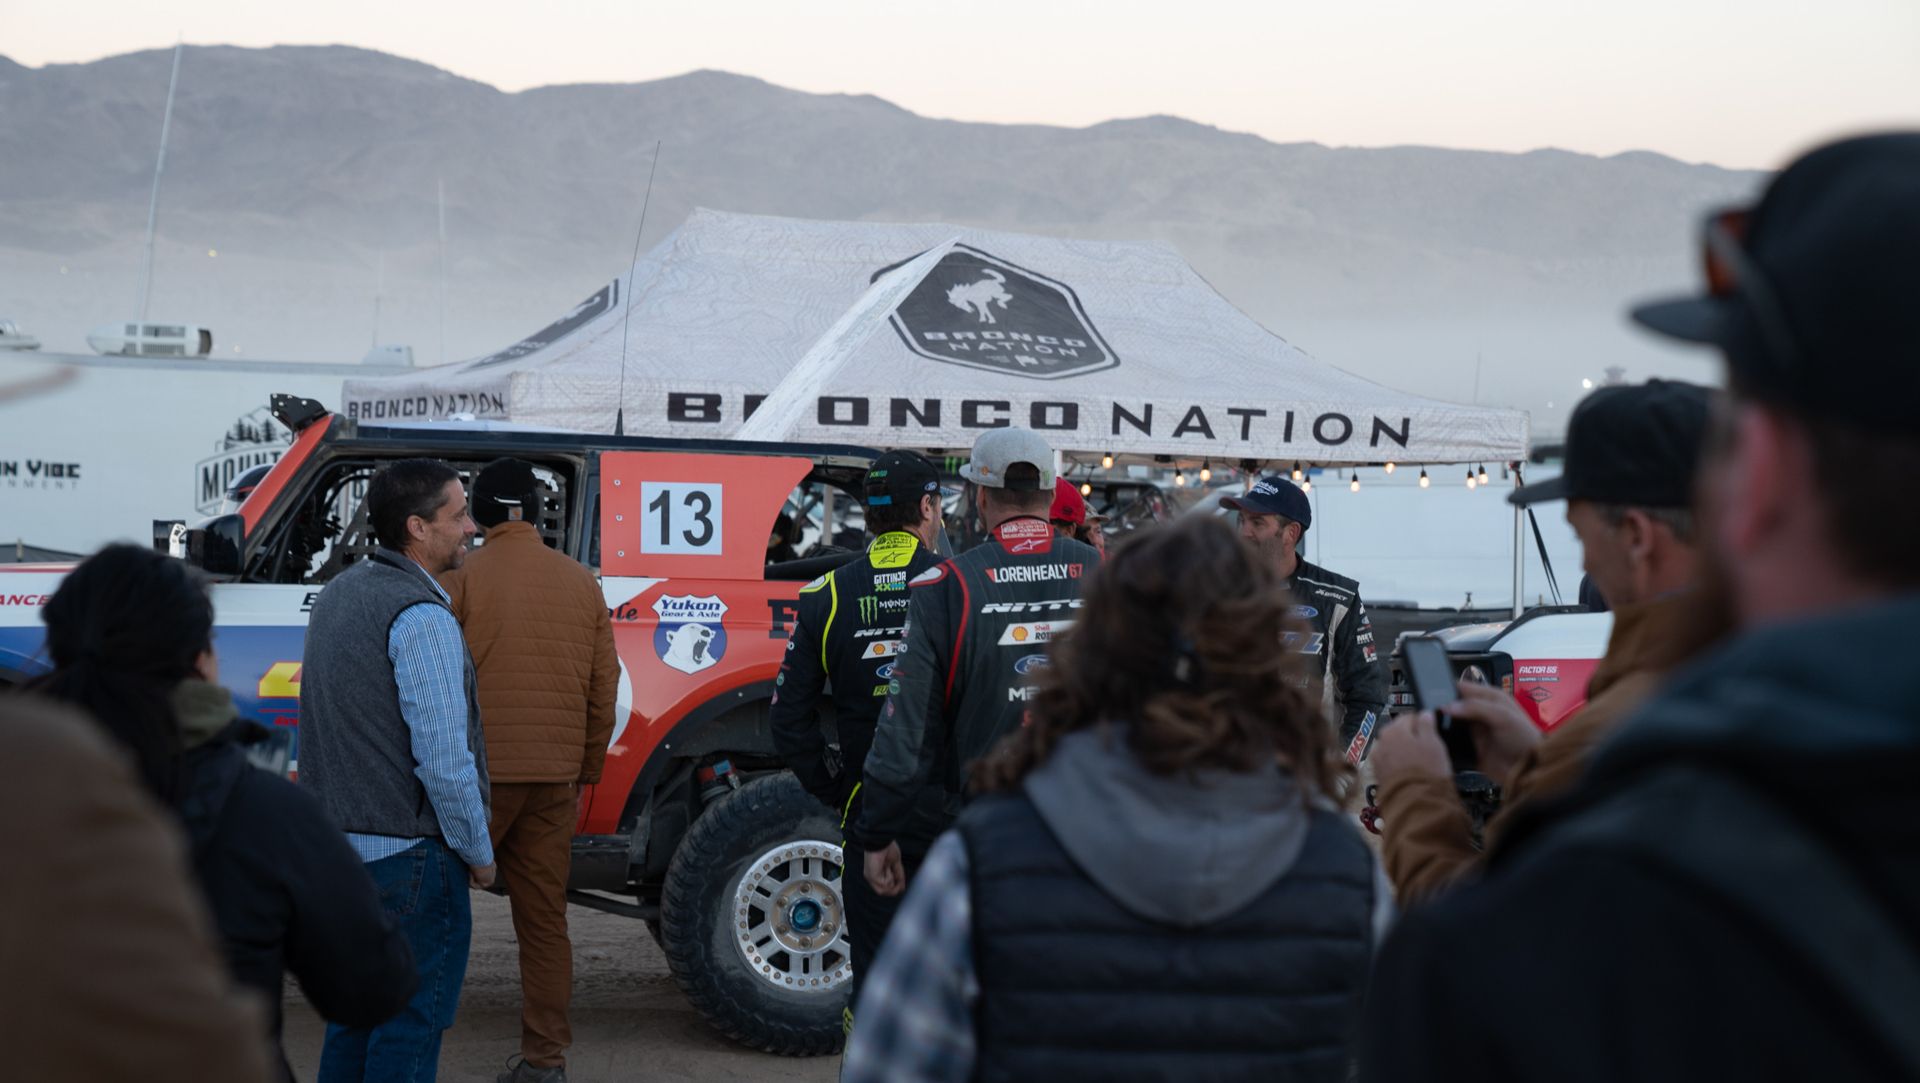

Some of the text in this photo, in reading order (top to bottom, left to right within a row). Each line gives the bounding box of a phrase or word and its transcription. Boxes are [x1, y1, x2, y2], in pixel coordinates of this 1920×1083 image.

[923, 332, 1087, 348] BRONCO
[949, 342, 1079, 358] NATION
[349, 392, 505, 421] BRONCO NATION
[1111, 401, 1411, 448] NATION
[648, 488, 714, 547] 13
[661, 599, 721, 612] Yukon
[661, 610, 685, 618] Gear
[1519, 666, 1547, 674] FACTOR
